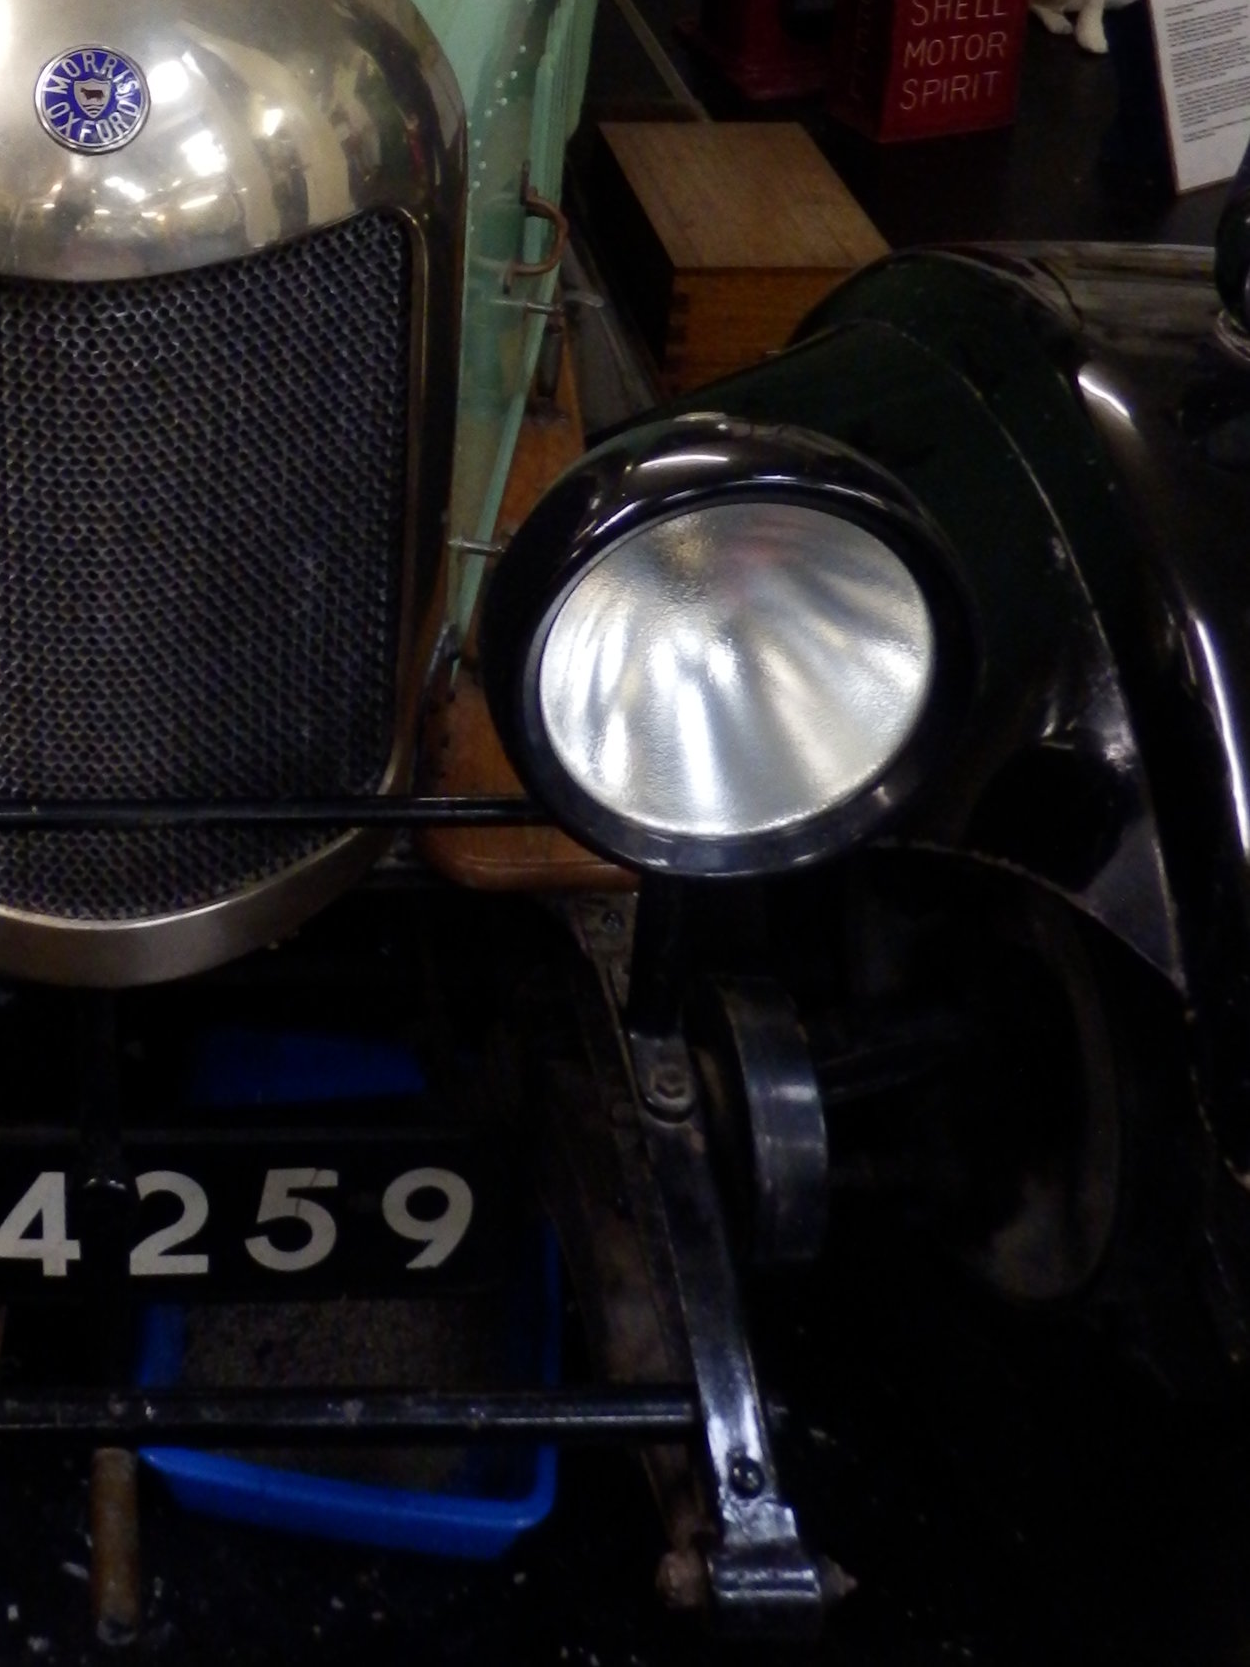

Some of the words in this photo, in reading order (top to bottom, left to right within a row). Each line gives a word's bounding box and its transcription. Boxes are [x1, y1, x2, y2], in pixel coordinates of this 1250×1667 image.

[903, 31, 1007, 69] MOTOR
[43, 51, 140, 97] MORRIS
[899, 70, 1001, 110] SPIRIT
[48, 101, 140, 143] OXFORD
